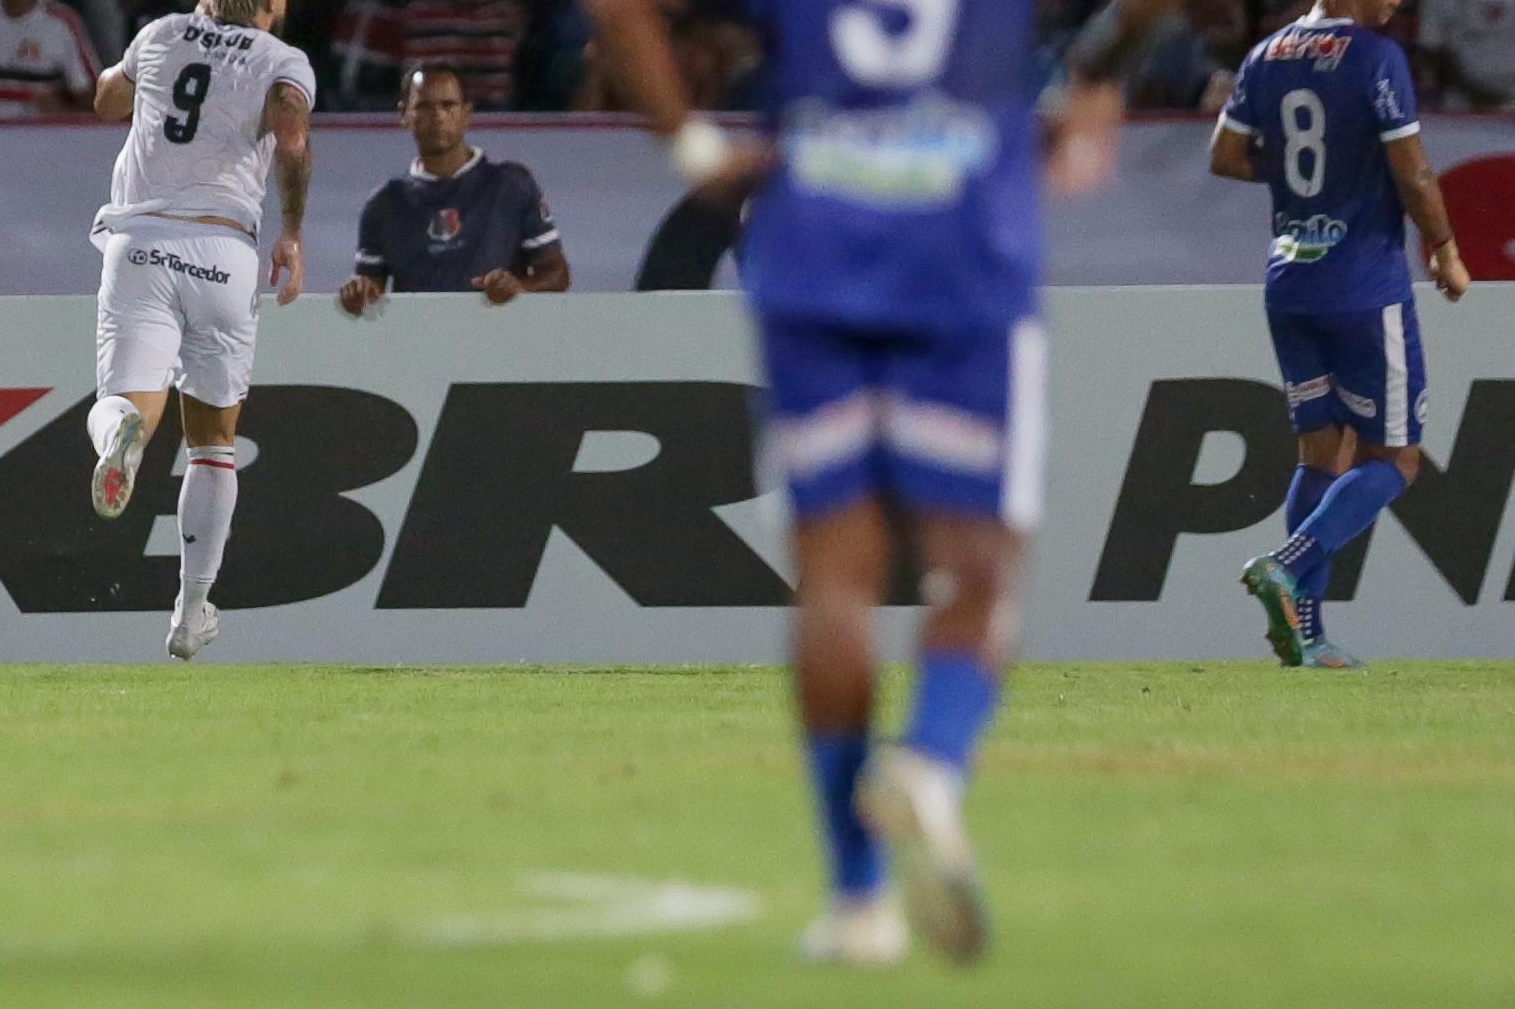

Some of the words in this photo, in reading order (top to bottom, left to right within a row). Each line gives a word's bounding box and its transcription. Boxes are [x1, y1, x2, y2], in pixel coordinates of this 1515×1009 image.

[164, 63, 211, 144] 9
[1280, 88, 1326, 198] 8
[150, 249, 230, 284] SrTorcedor
[1089, 377, 1515, 605] PN
